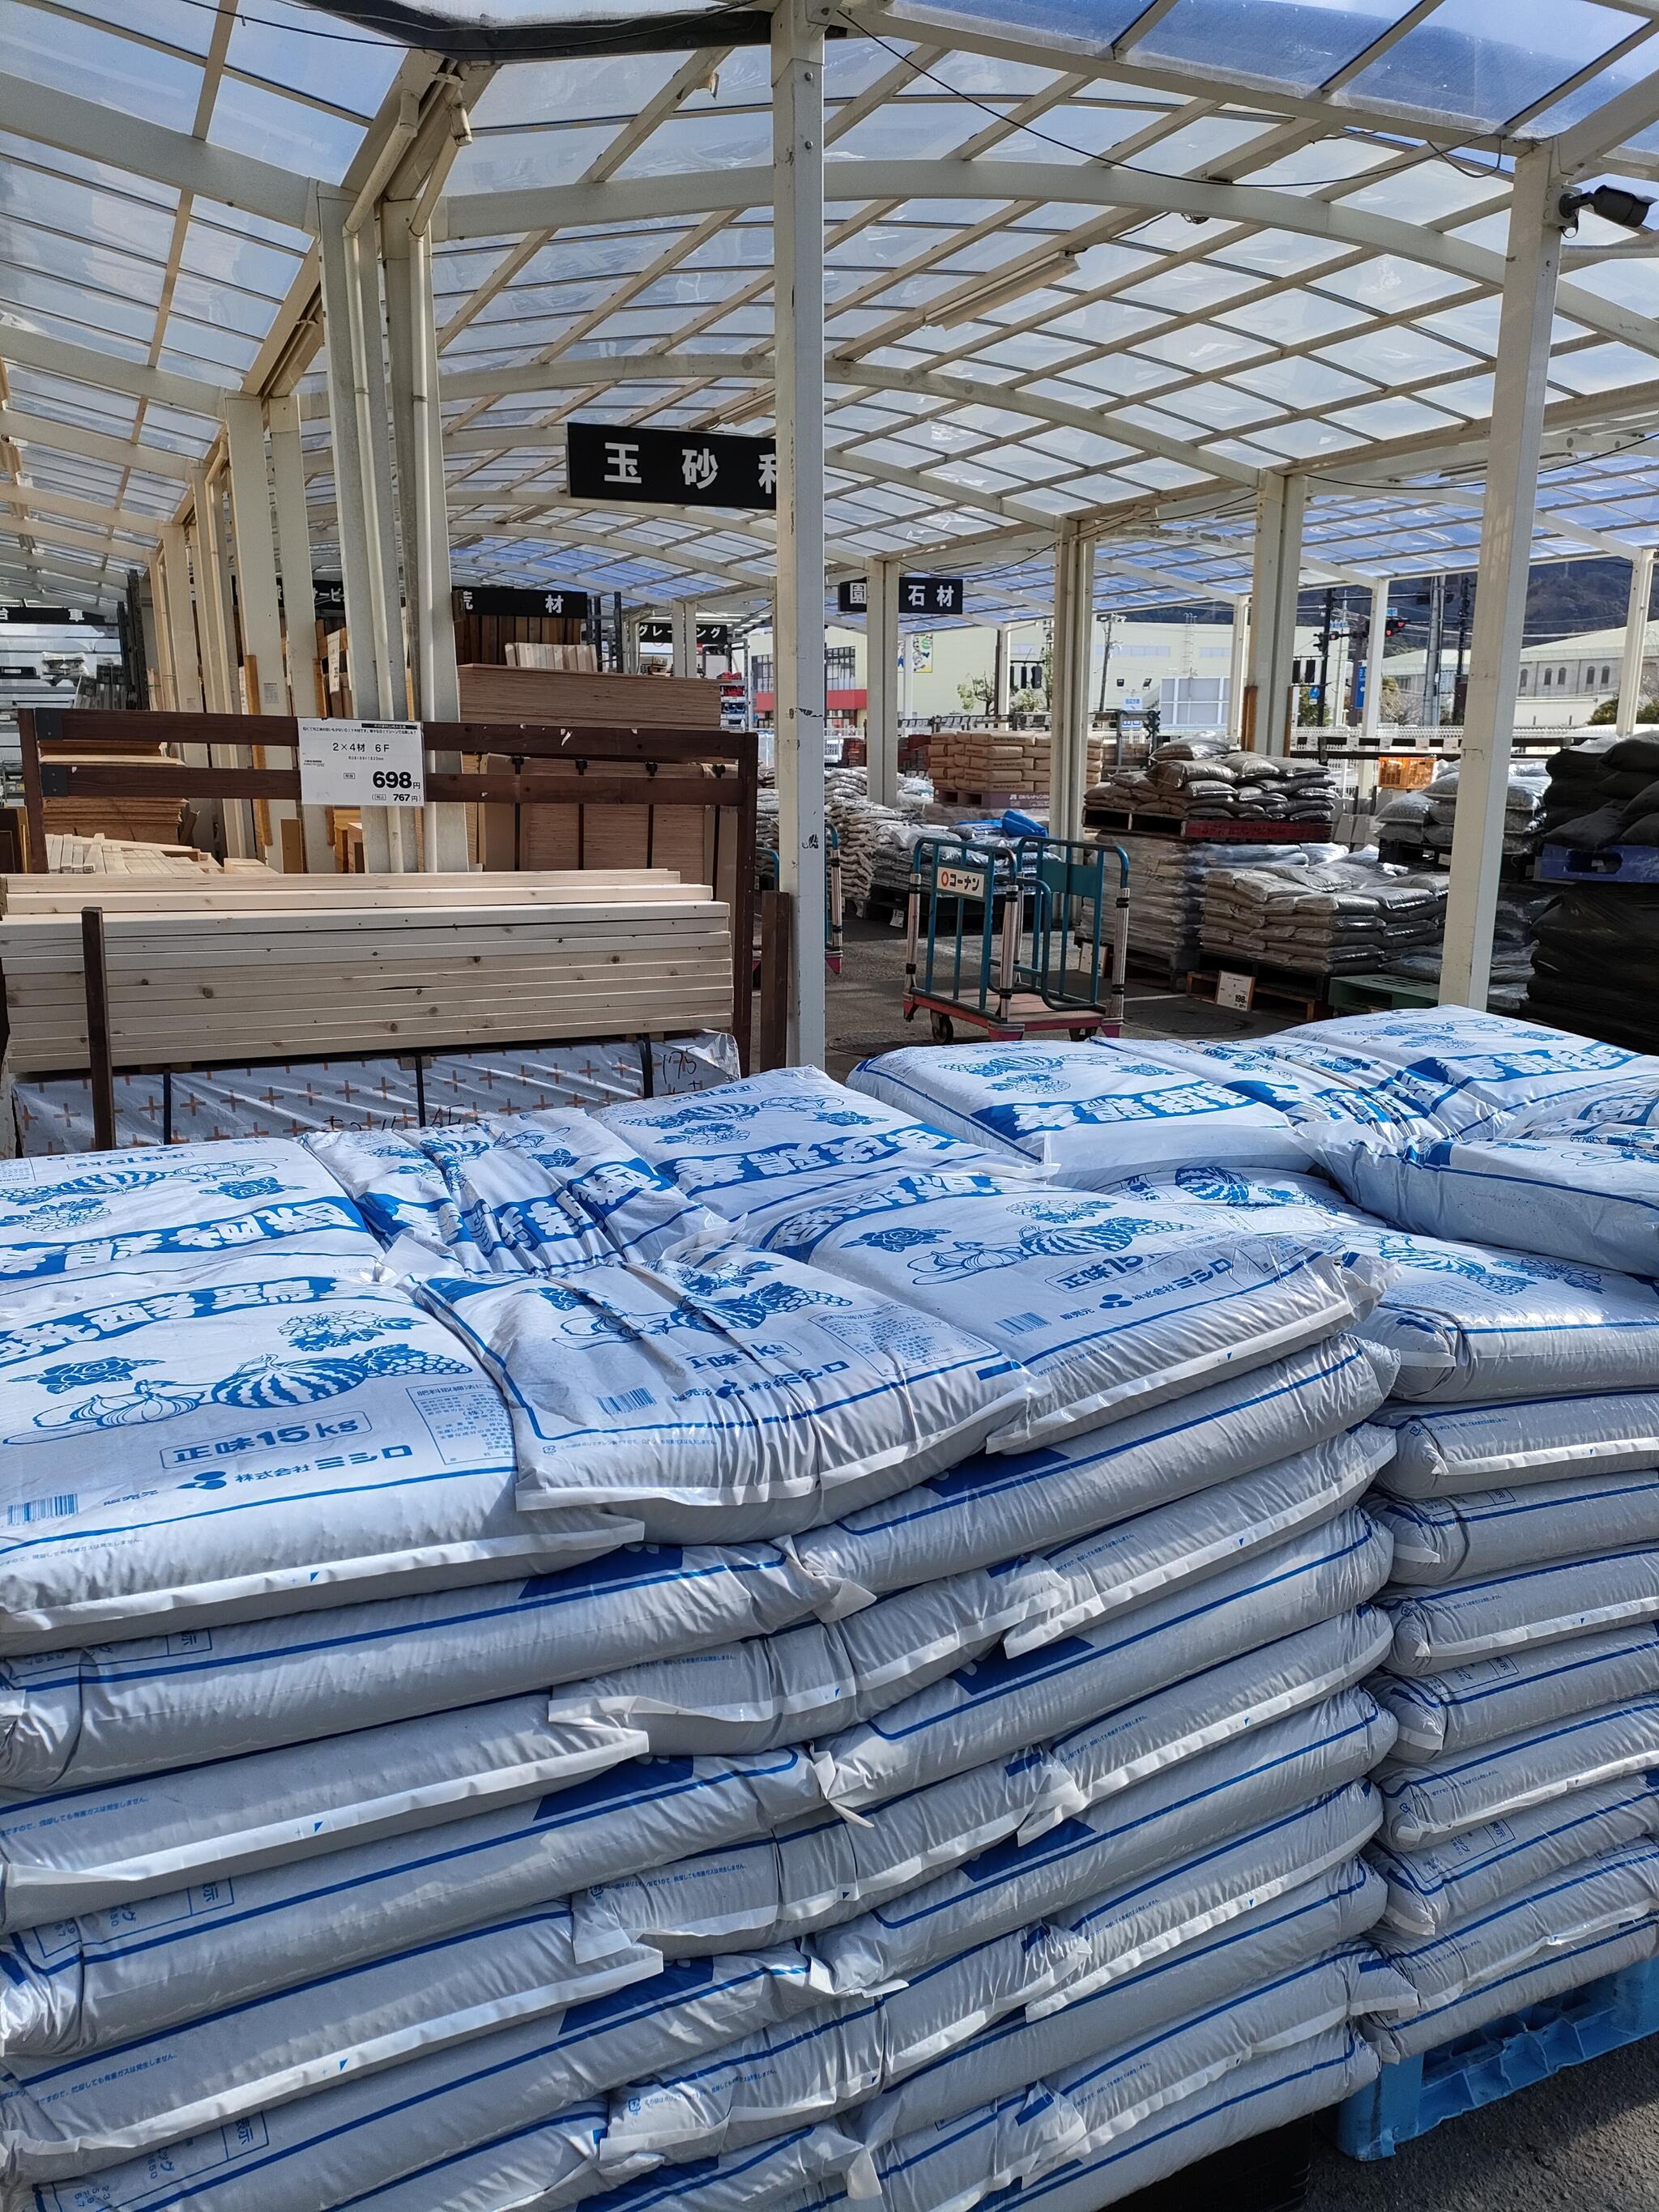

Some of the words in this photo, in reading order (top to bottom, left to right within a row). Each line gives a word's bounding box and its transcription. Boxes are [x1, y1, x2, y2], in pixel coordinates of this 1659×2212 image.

[850, 582, 954, 607] 園石材
[639, 624, 721, 639] グレーング
[332, 742, 365, 752] 2×4材
[375, 744, 390, 752] 6F
[373, 770, 421, 790] 698円
[949, 873, 979, 891] コーナン
[173, 1419, 359, 1464] 正味15kg
